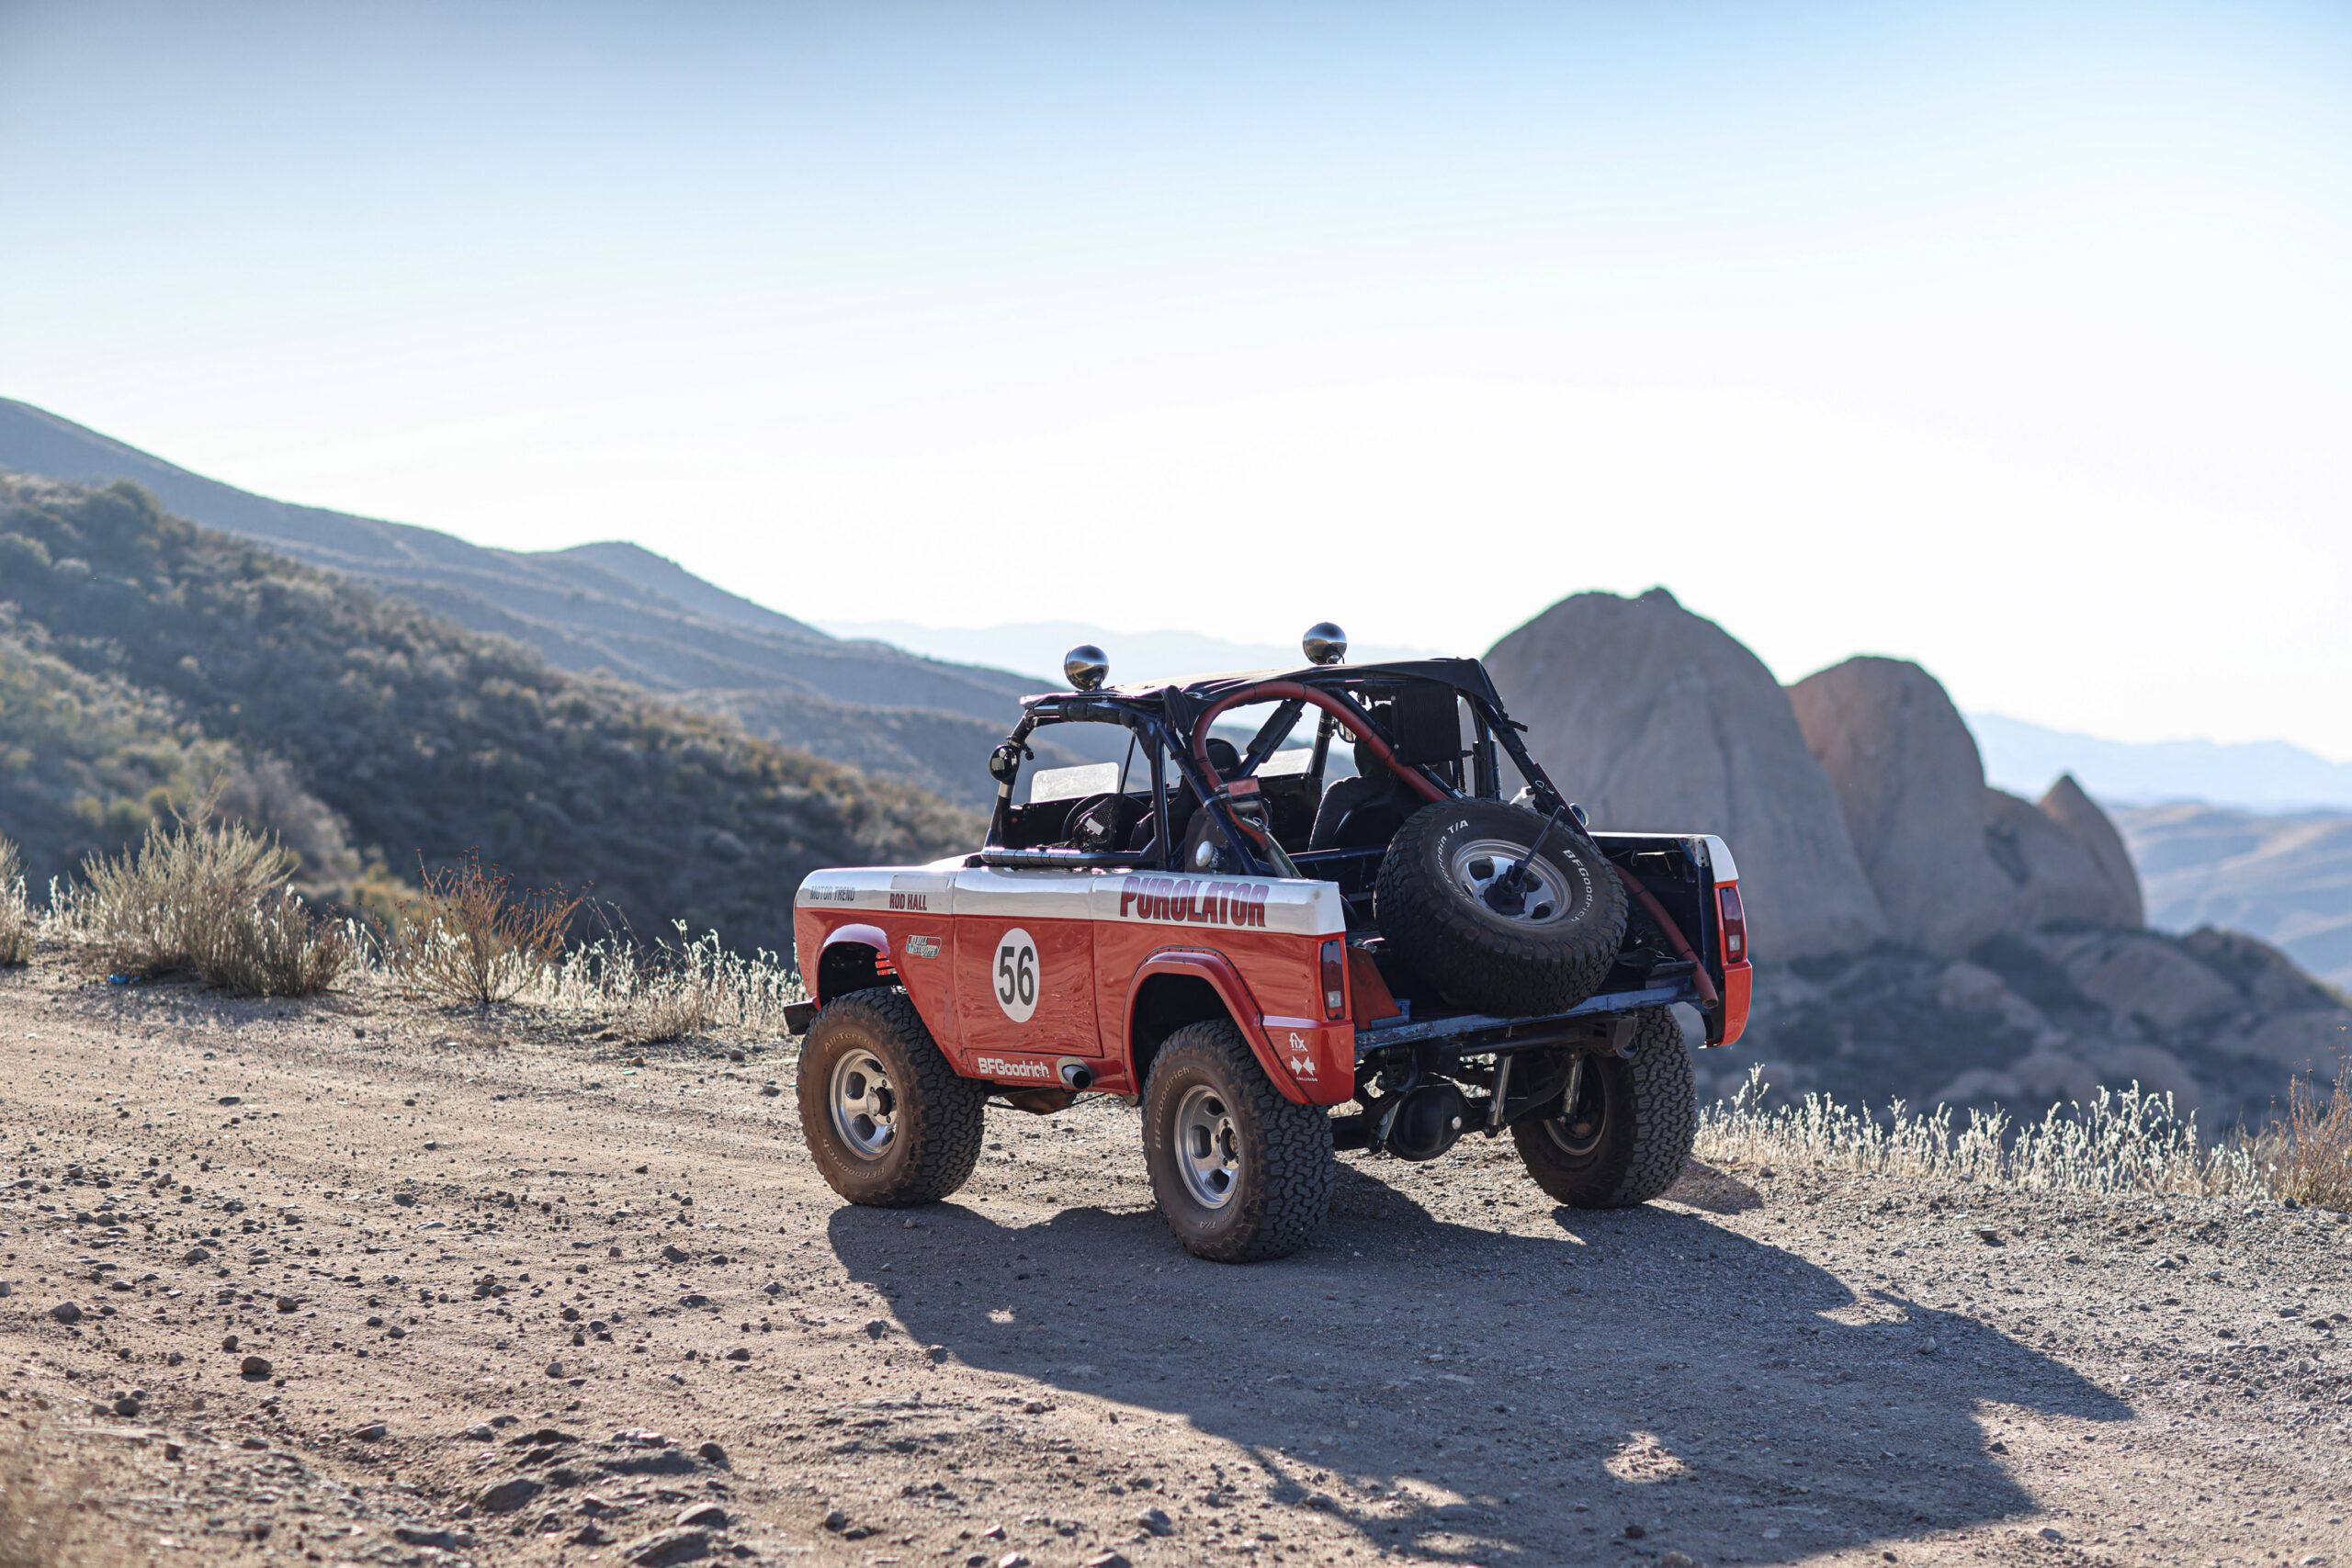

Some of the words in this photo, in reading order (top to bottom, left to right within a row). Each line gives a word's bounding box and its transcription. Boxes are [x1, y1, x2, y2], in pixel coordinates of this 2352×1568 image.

[1447, 819, 1469, 834] T/A
[810, 886, 832, 900] MOTOR
[834, 887, 855, 901] TREND
[889, 893, 905, 909] ROD
[908, 894, 927, 911] HALL
[1120, 876, 1269, 927] PUROLATOR
[1562, 849, 1593, 922] BFGoodrich
[998, 946, 1035, 1006] 56
[978, 1057, 1050, 1078] BFGoodrich
[1155, 1066, 1191, 1149] BFGoodrich
